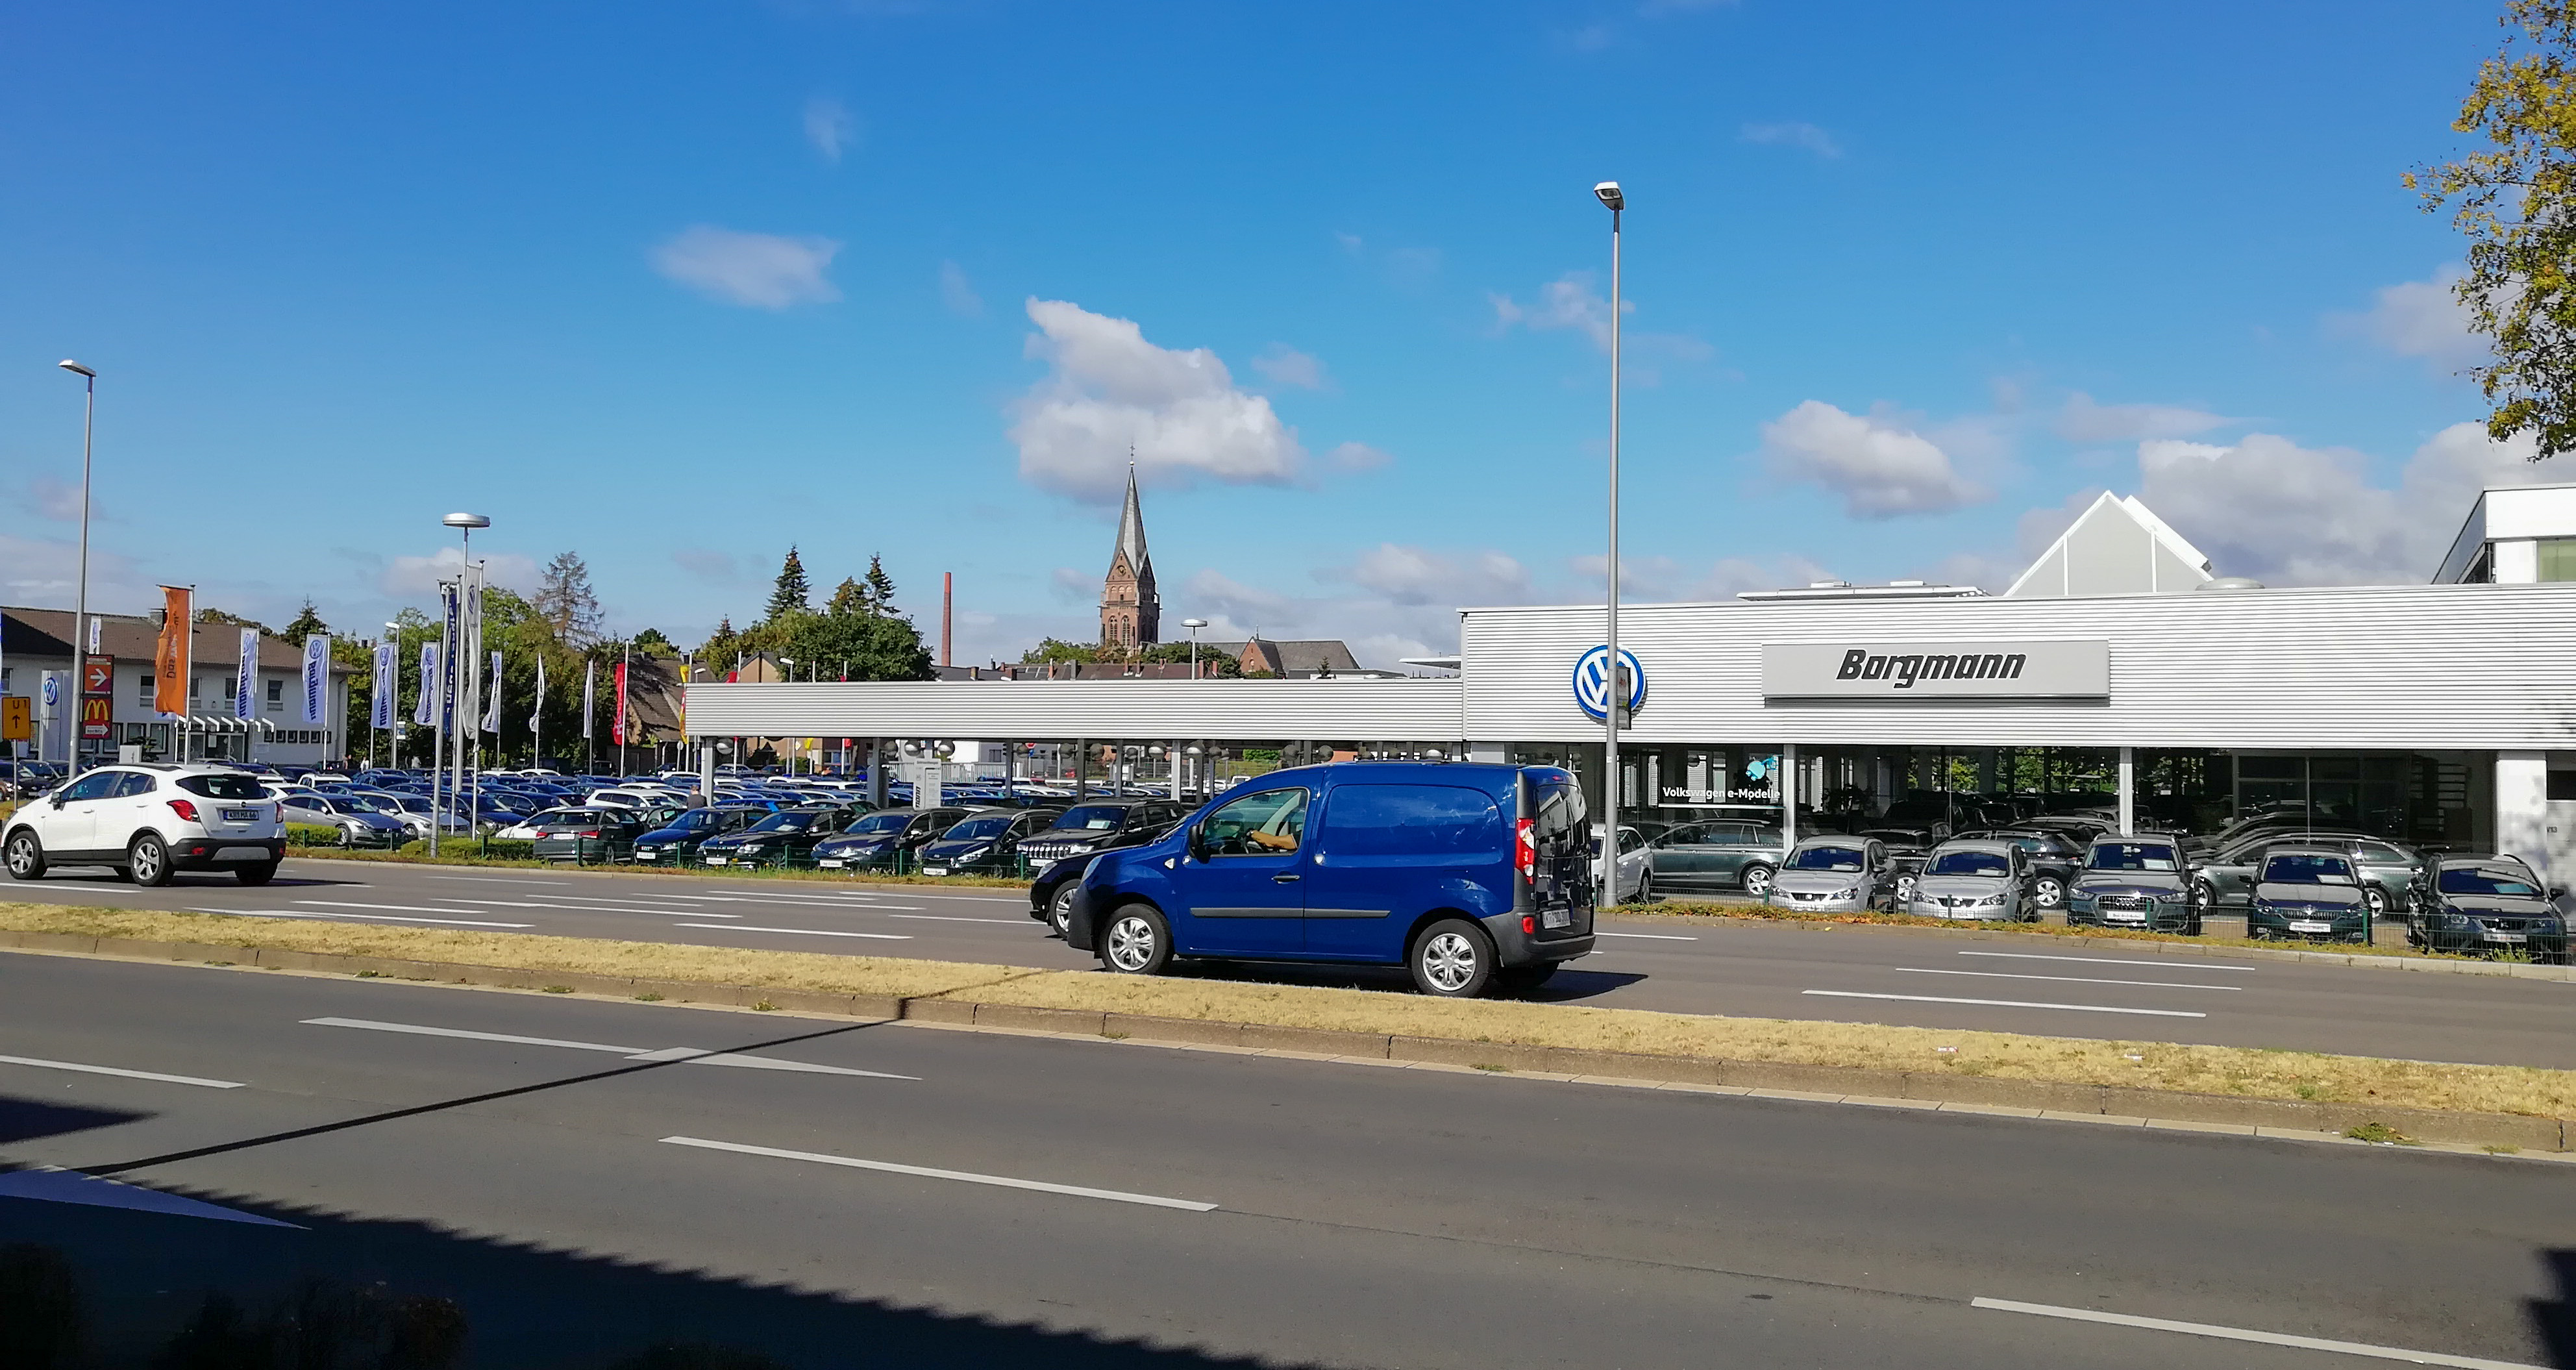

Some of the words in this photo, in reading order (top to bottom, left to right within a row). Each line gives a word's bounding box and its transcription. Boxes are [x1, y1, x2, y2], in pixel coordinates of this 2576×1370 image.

[1836, 649, 2026, 688] Borgmann
[1663, 787, 1725, 800] Volkswagen
[1728, 788, 1780, 799] e-Modelle
